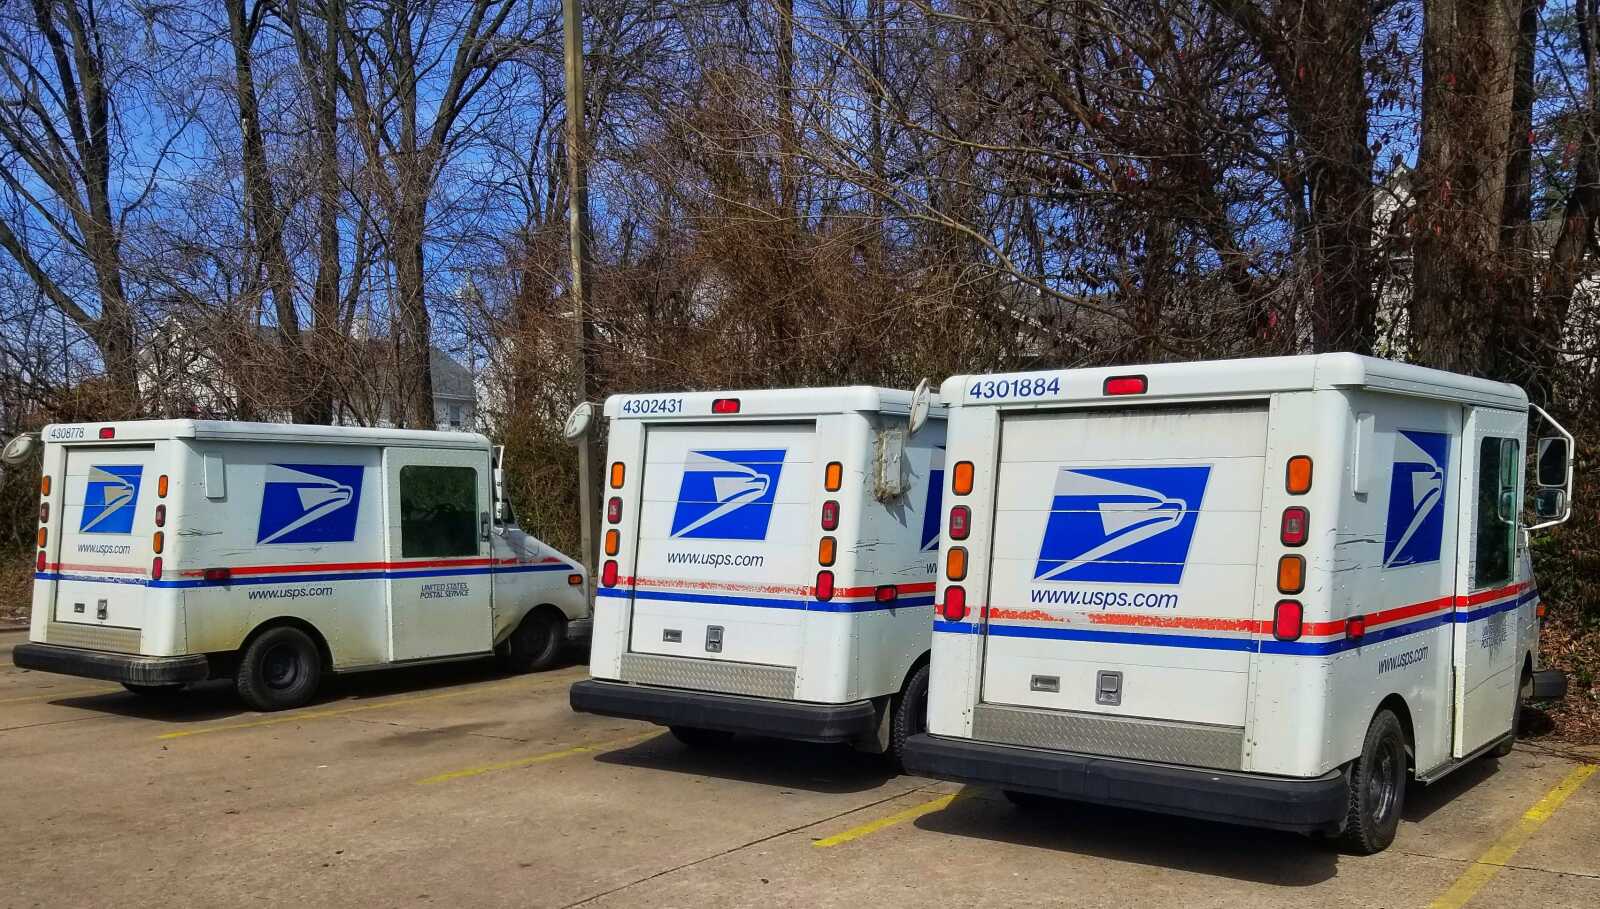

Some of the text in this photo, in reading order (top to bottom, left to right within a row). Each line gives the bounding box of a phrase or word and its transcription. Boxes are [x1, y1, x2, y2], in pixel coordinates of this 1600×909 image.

[969, 377, 1060, 399] 4301884
[623, 399, 684, 414] 4302431
[77, 543, 131, 556] www.usps.com
[667, 552, 764, 568] www.usps.com
[248, 587, 333, 600] www.usps.com
[420, 589, 469, 599] POSTAL SERVICE
[421, 582, 468, 591] UNITED STATES
[1031, 589, 1178, 610] www.usps.com
[1378, 646, 1429, 674] www.usps.com
